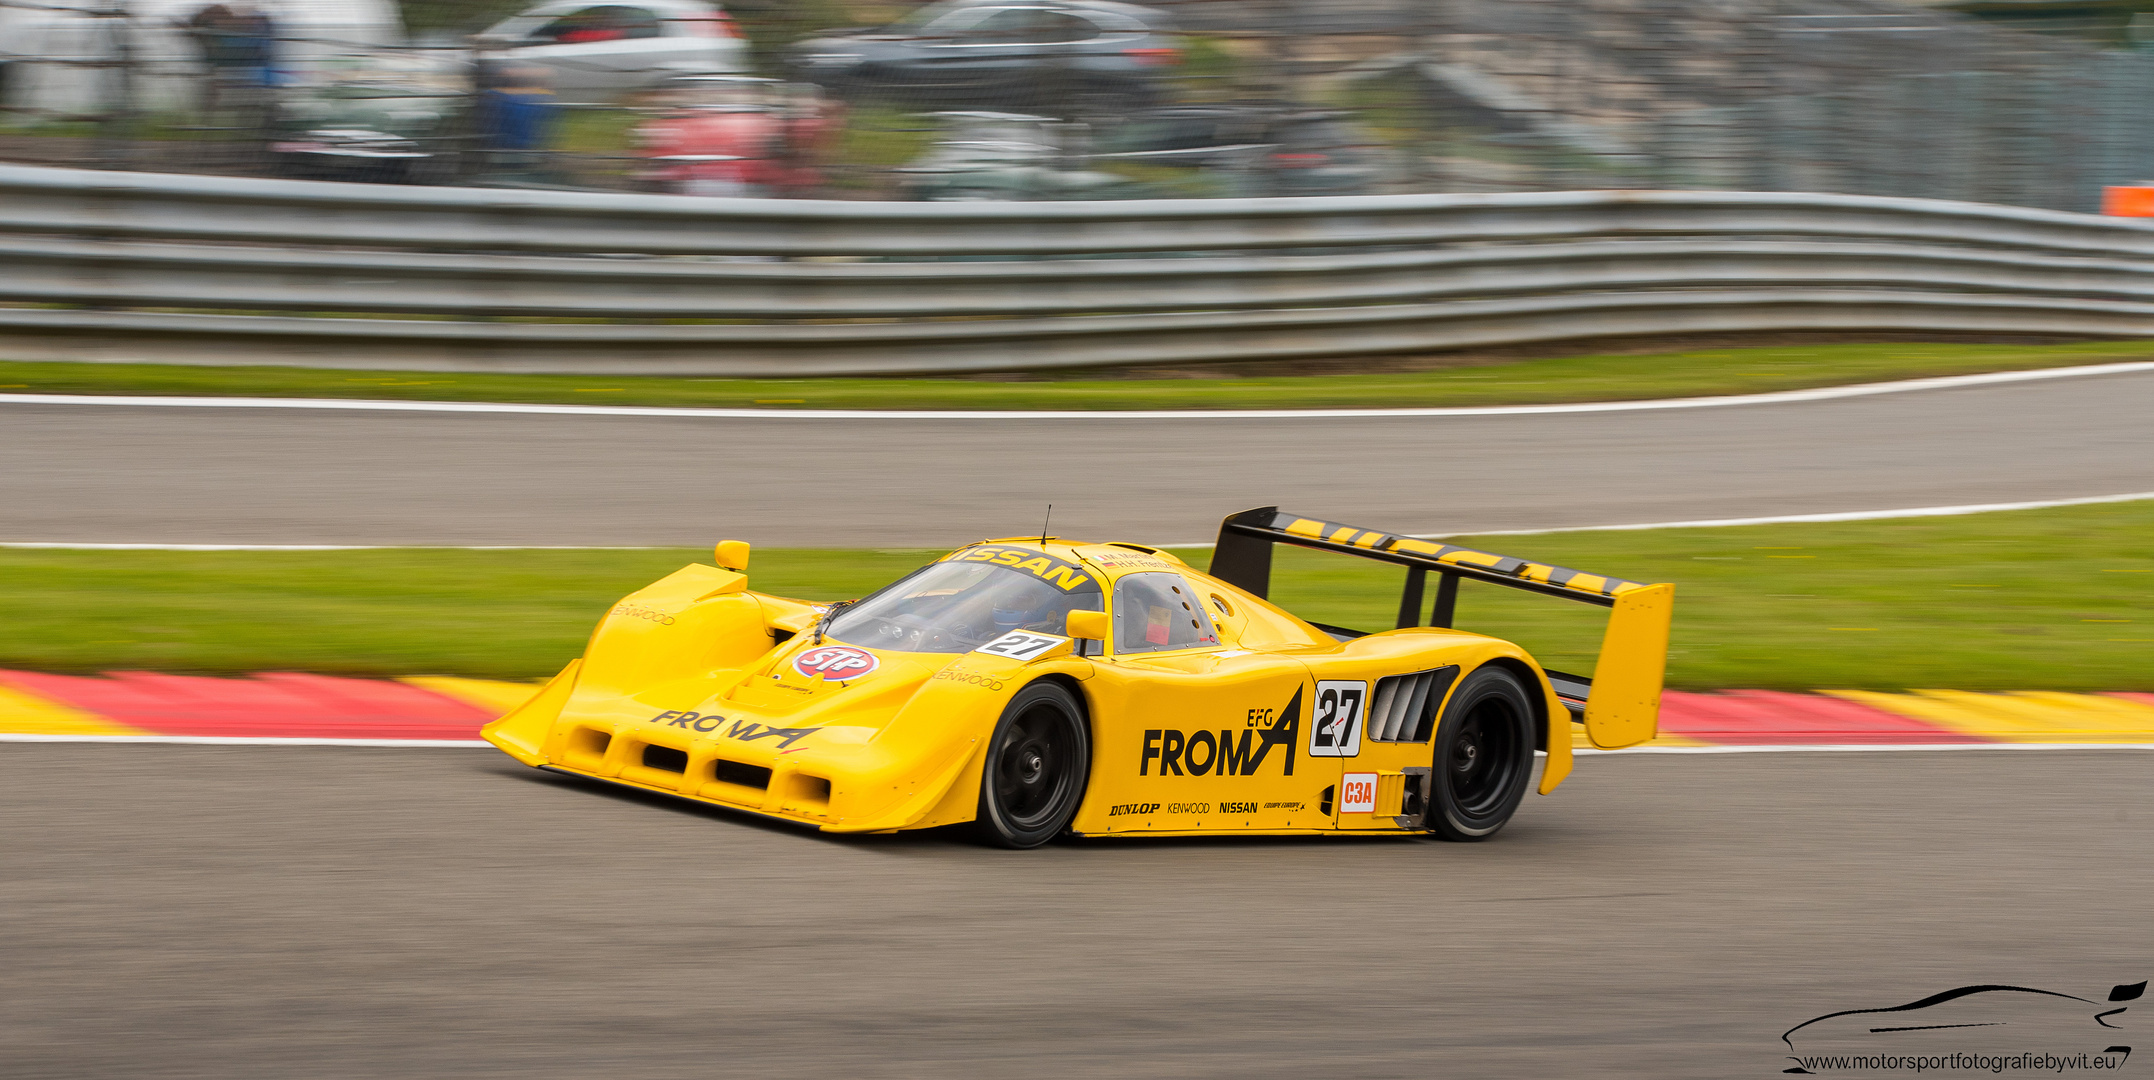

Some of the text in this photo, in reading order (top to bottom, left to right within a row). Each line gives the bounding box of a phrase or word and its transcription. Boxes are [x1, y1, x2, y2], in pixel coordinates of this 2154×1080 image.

[609, 606, 676, 626] ENWOOD
[985, 635, 1056, 656] 27
[800, 649, 868, 672] STP
[1247, 708, 1273, 727] EFG
[1314, 688, 1362, 747] 27
[1344, 782, 1372, 804] C3A
[1109, 803, 1161, 816] DUNLOP
[1167, 802, 1210, 814] KENWOOD
[1219, 802, 1258, 814] NISSAN
